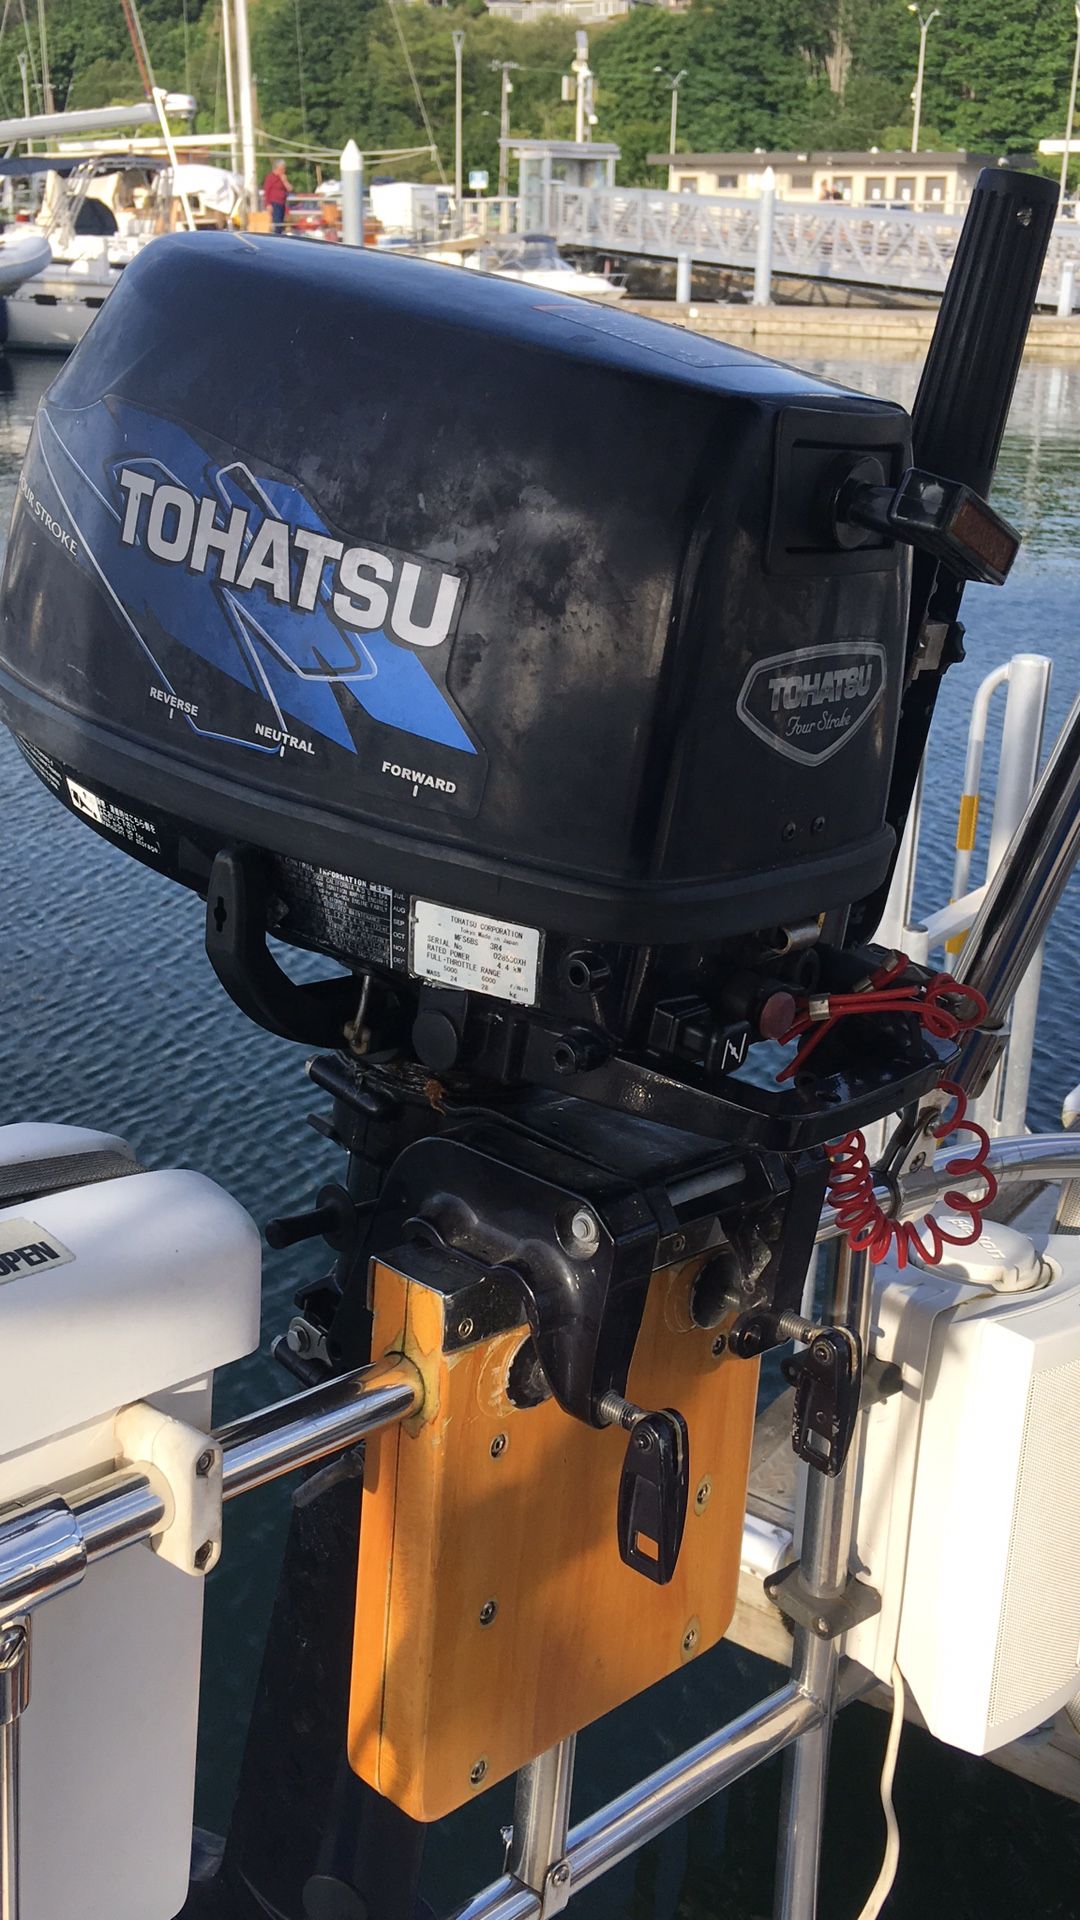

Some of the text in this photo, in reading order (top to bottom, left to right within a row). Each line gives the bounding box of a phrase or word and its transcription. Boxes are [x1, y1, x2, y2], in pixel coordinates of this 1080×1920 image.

[34, 501, 78, 556] STROKE
[119, 468, 460, 648] TOHATSU
[768, 664, 872, 711] TOHATSU
[149, 686, 199, 717] REVERSE
[785, 707, 851, 736] Four Stroke
[254, 723, 315, 755] NEUTRAL
[381, 761, 457, 794] FORWARD
[319, 867, 367, 887] INFORMATION
[427, 935, 450, 947] SERIAL
[451, 915, 523, 940] TOHATSU CORPORATION
[426, 944, 447, 955] RATED
[449, 949, 470, 960] POWER
[426, 969, 441, 978] MASS
[450, 975, 458, 983] 24
[480, 966, 501, 977] RANGE
[481, 976, 497, 985] 6000
